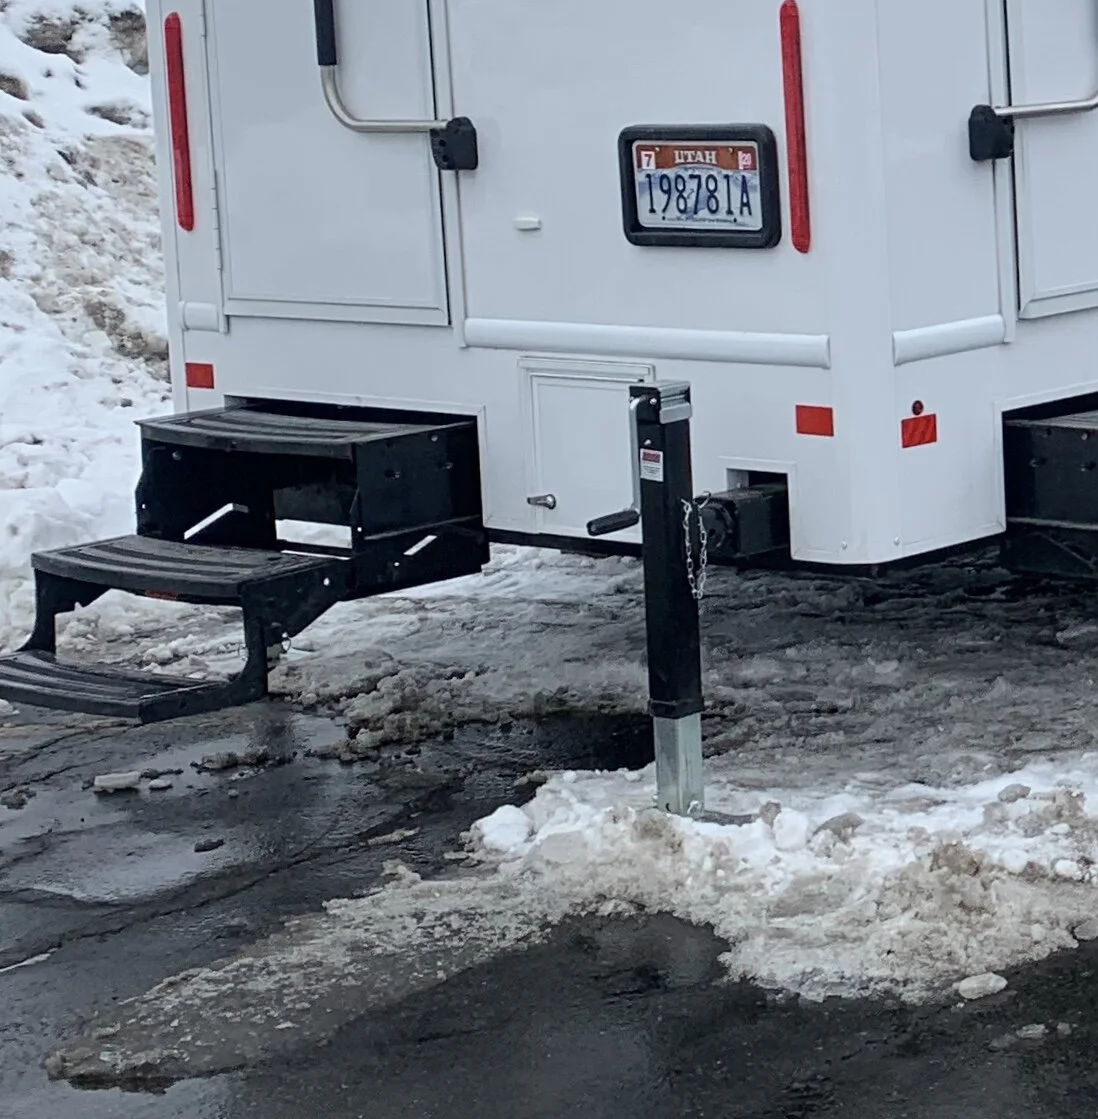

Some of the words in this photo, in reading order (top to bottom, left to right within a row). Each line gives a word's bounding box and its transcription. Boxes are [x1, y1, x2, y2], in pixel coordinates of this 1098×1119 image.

[643, 154, 652, 168] 7
[674, 150, 717, 164] UTAH
[645, 174, 752, 216] 198781A
